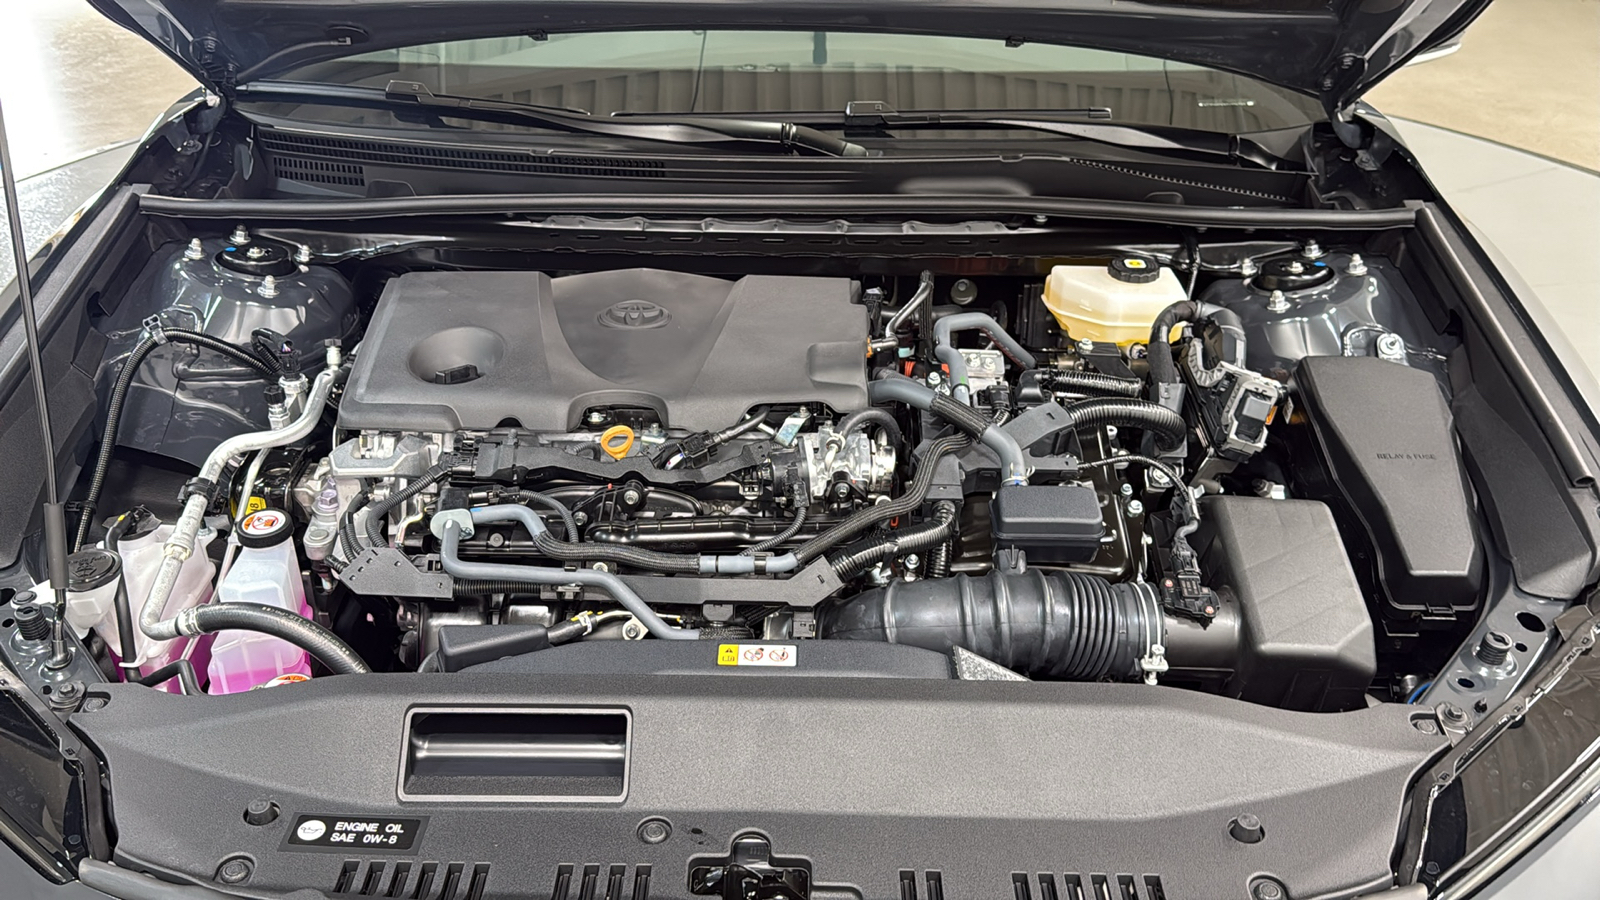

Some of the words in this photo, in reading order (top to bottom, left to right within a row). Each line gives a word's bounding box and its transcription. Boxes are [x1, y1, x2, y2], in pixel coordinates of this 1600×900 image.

[334, 821, 380, 832] ENGINE
[384, 823, 405, 833] OIL
[330, 832, 356, 843] SAE
[362, 834, 398, 844] 0W-8
